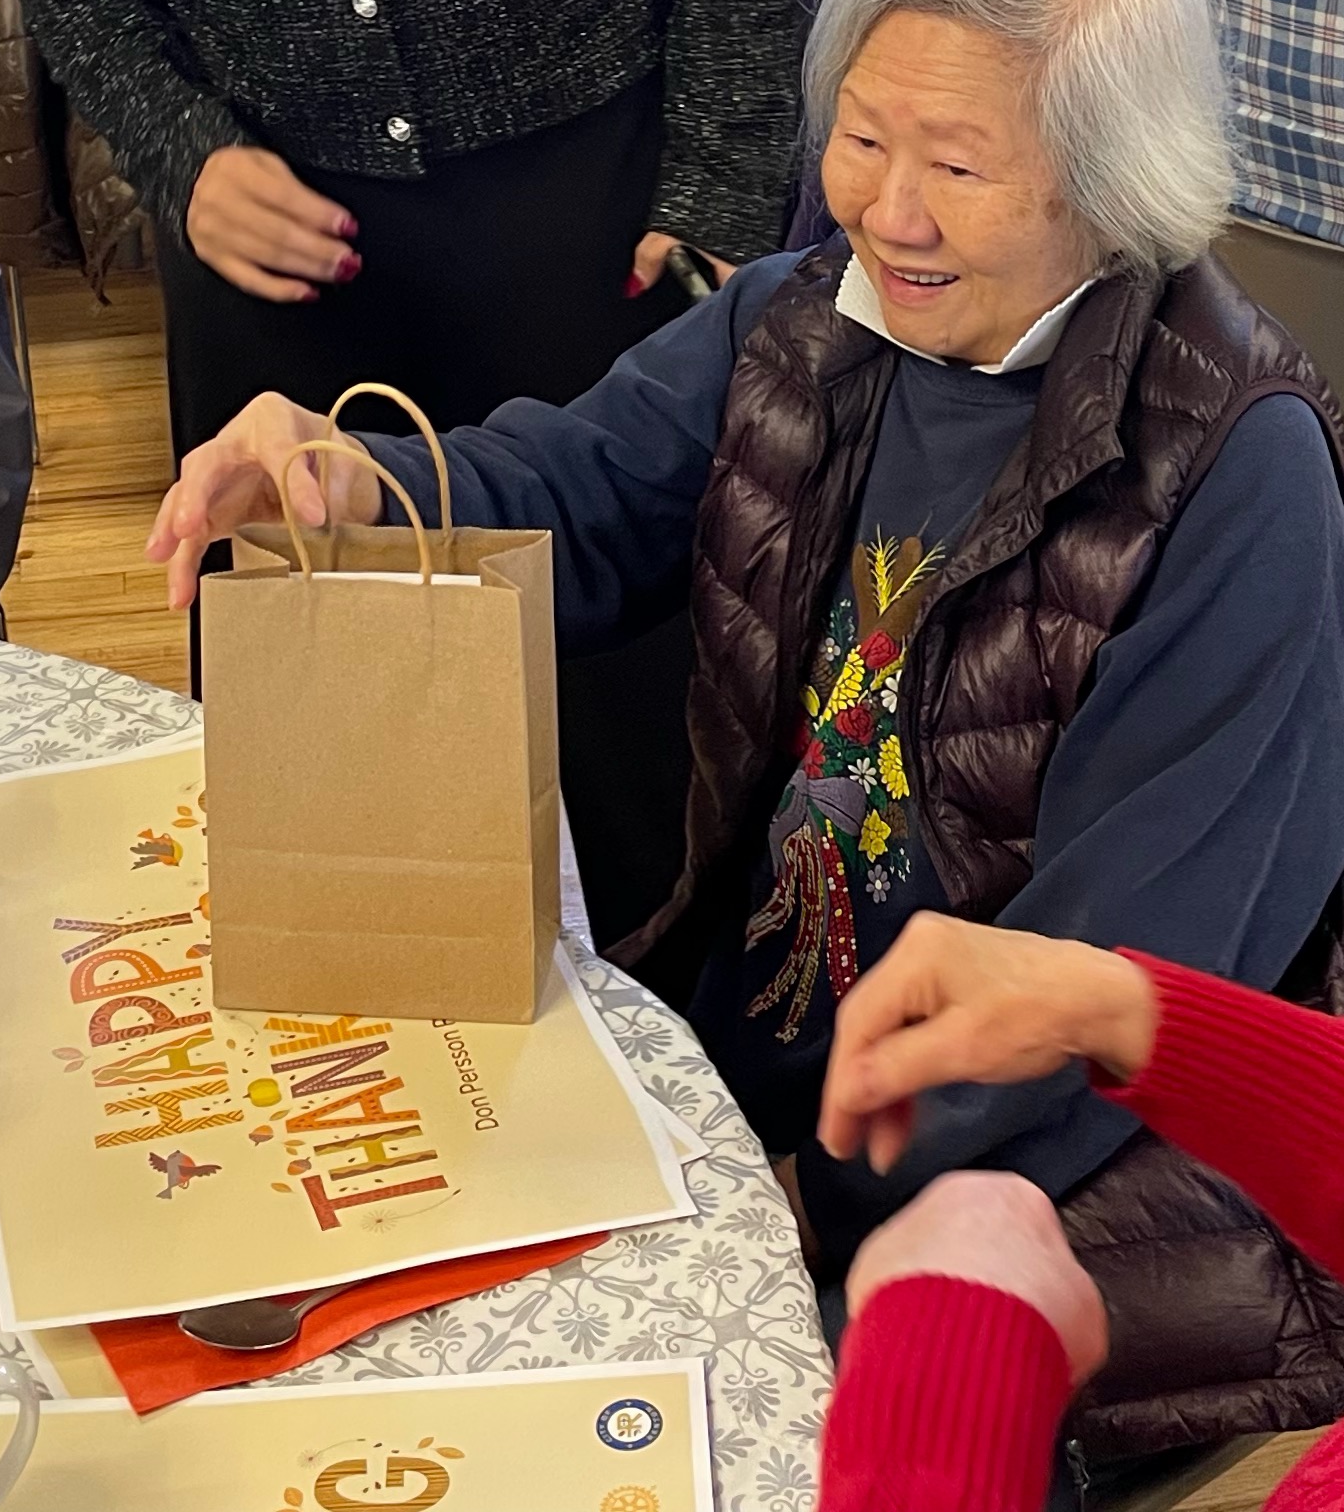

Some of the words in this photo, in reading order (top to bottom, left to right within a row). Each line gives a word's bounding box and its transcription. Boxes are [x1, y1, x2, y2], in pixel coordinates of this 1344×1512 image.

[53, 912, 245, 1149] HAPPY
[443, 1029, 484, 1095] Persson
[263, 1014, 449, 1232] THANK
[470, 1095, 500, 1131] Don
